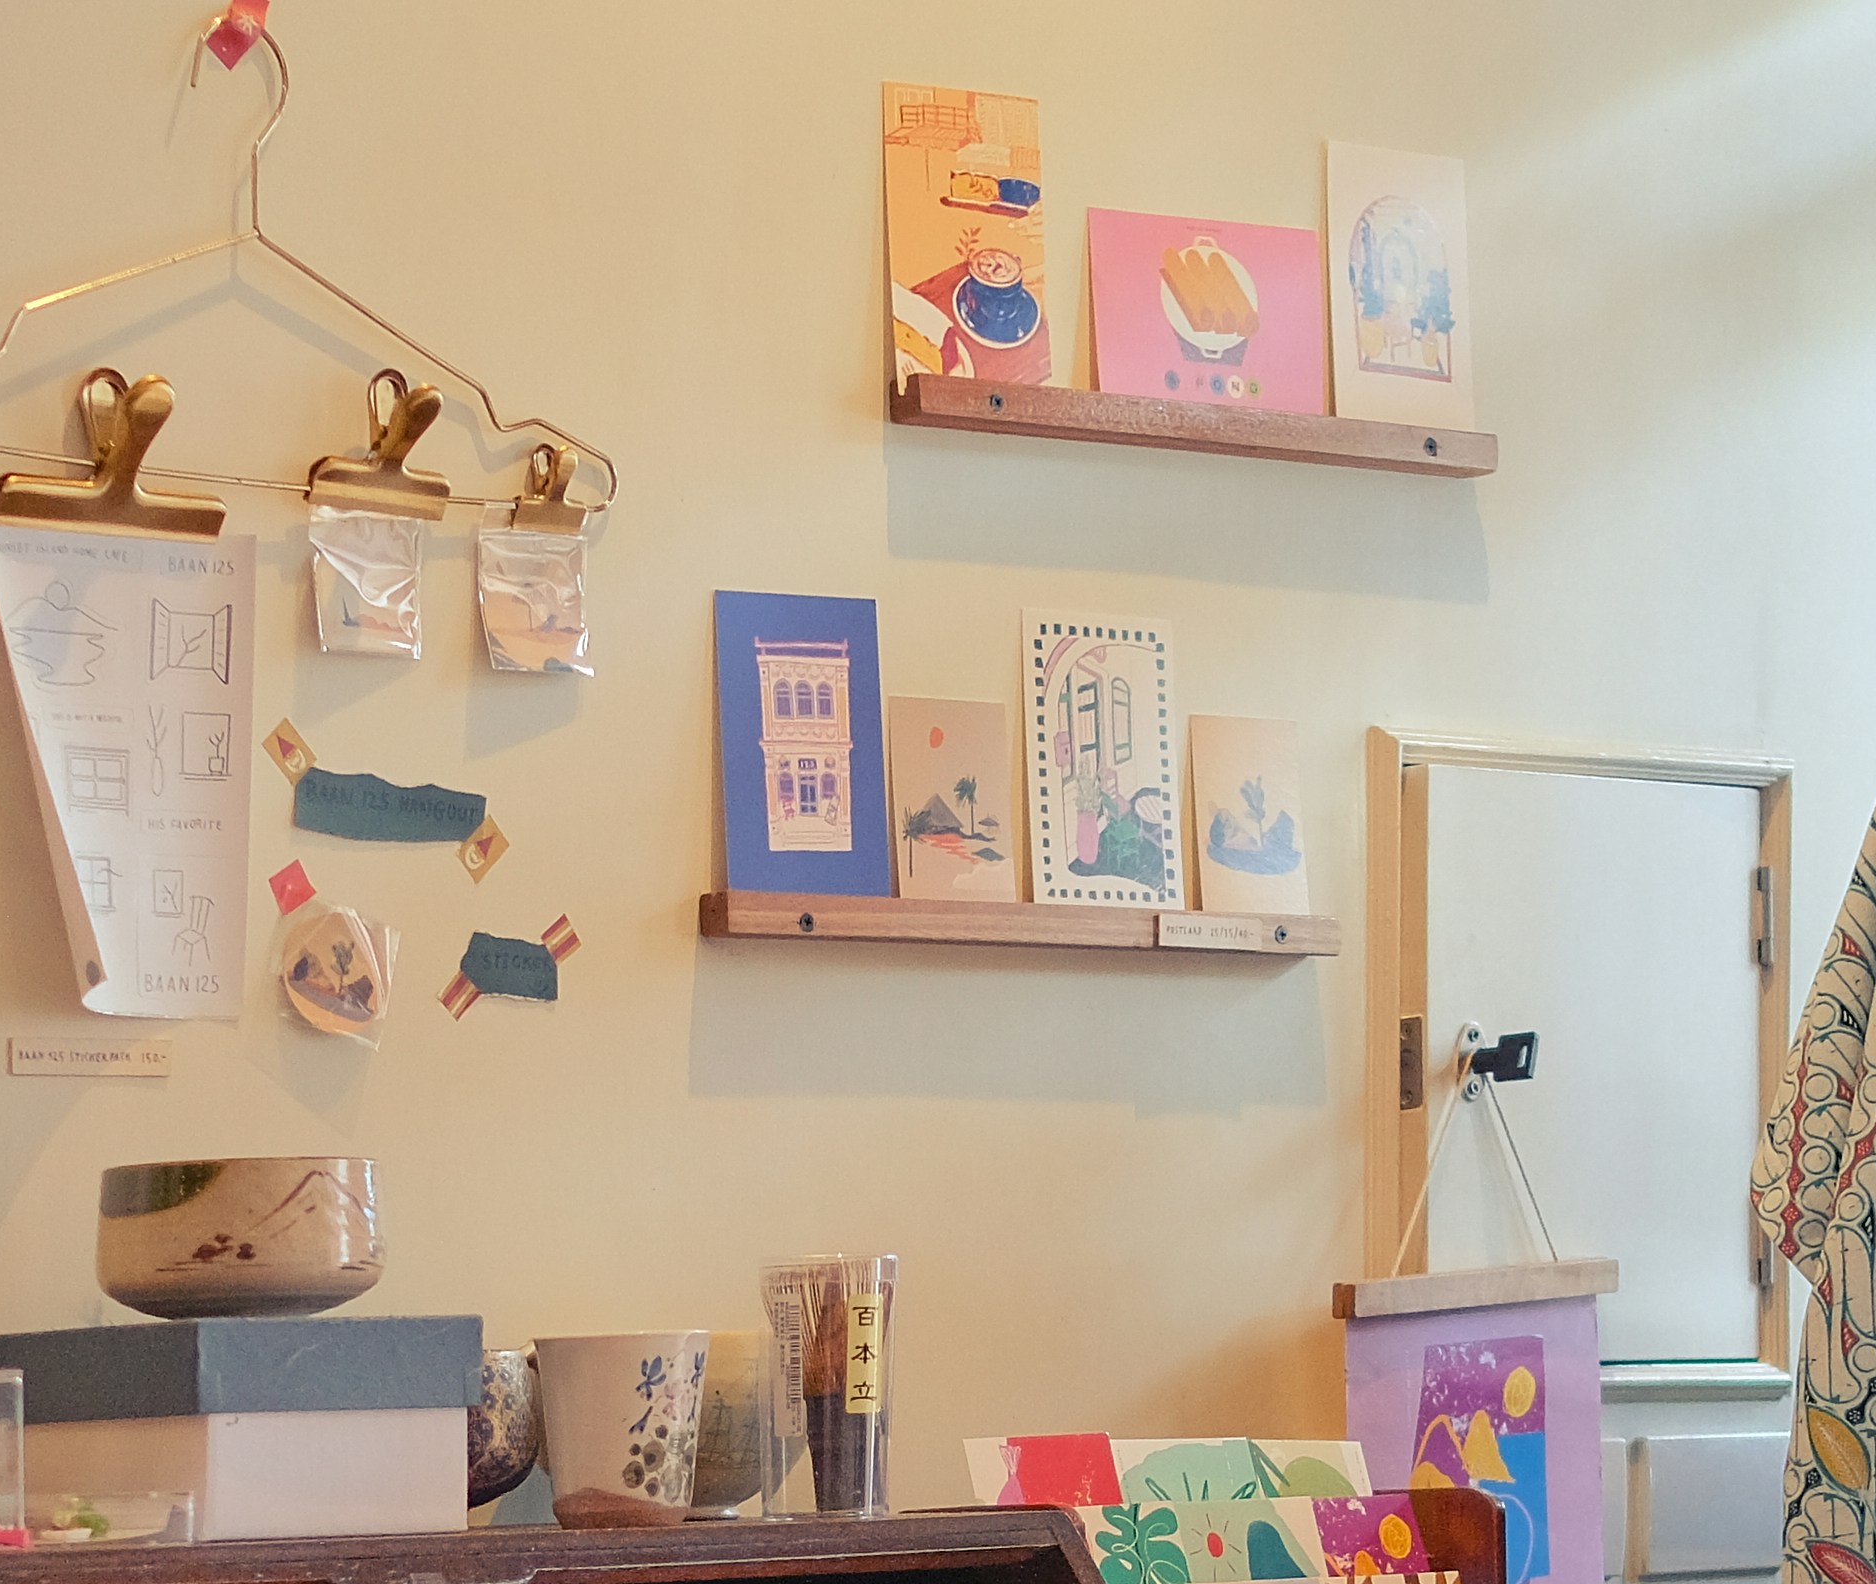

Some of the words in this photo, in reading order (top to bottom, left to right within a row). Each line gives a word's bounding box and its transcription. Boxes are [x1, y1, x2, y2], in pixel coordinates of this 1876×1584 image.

[168, 555, 207, 573] BAAN
[212, 558, 235, 575] 125
[148, 819, 165, 831] HIS
[170, 817, 222, 831] FAVORITE
[144, 973, 189, 993] BAAN
[195, 974, 220, 994] 125
[849, 1305, 879, 1402] 百本立
